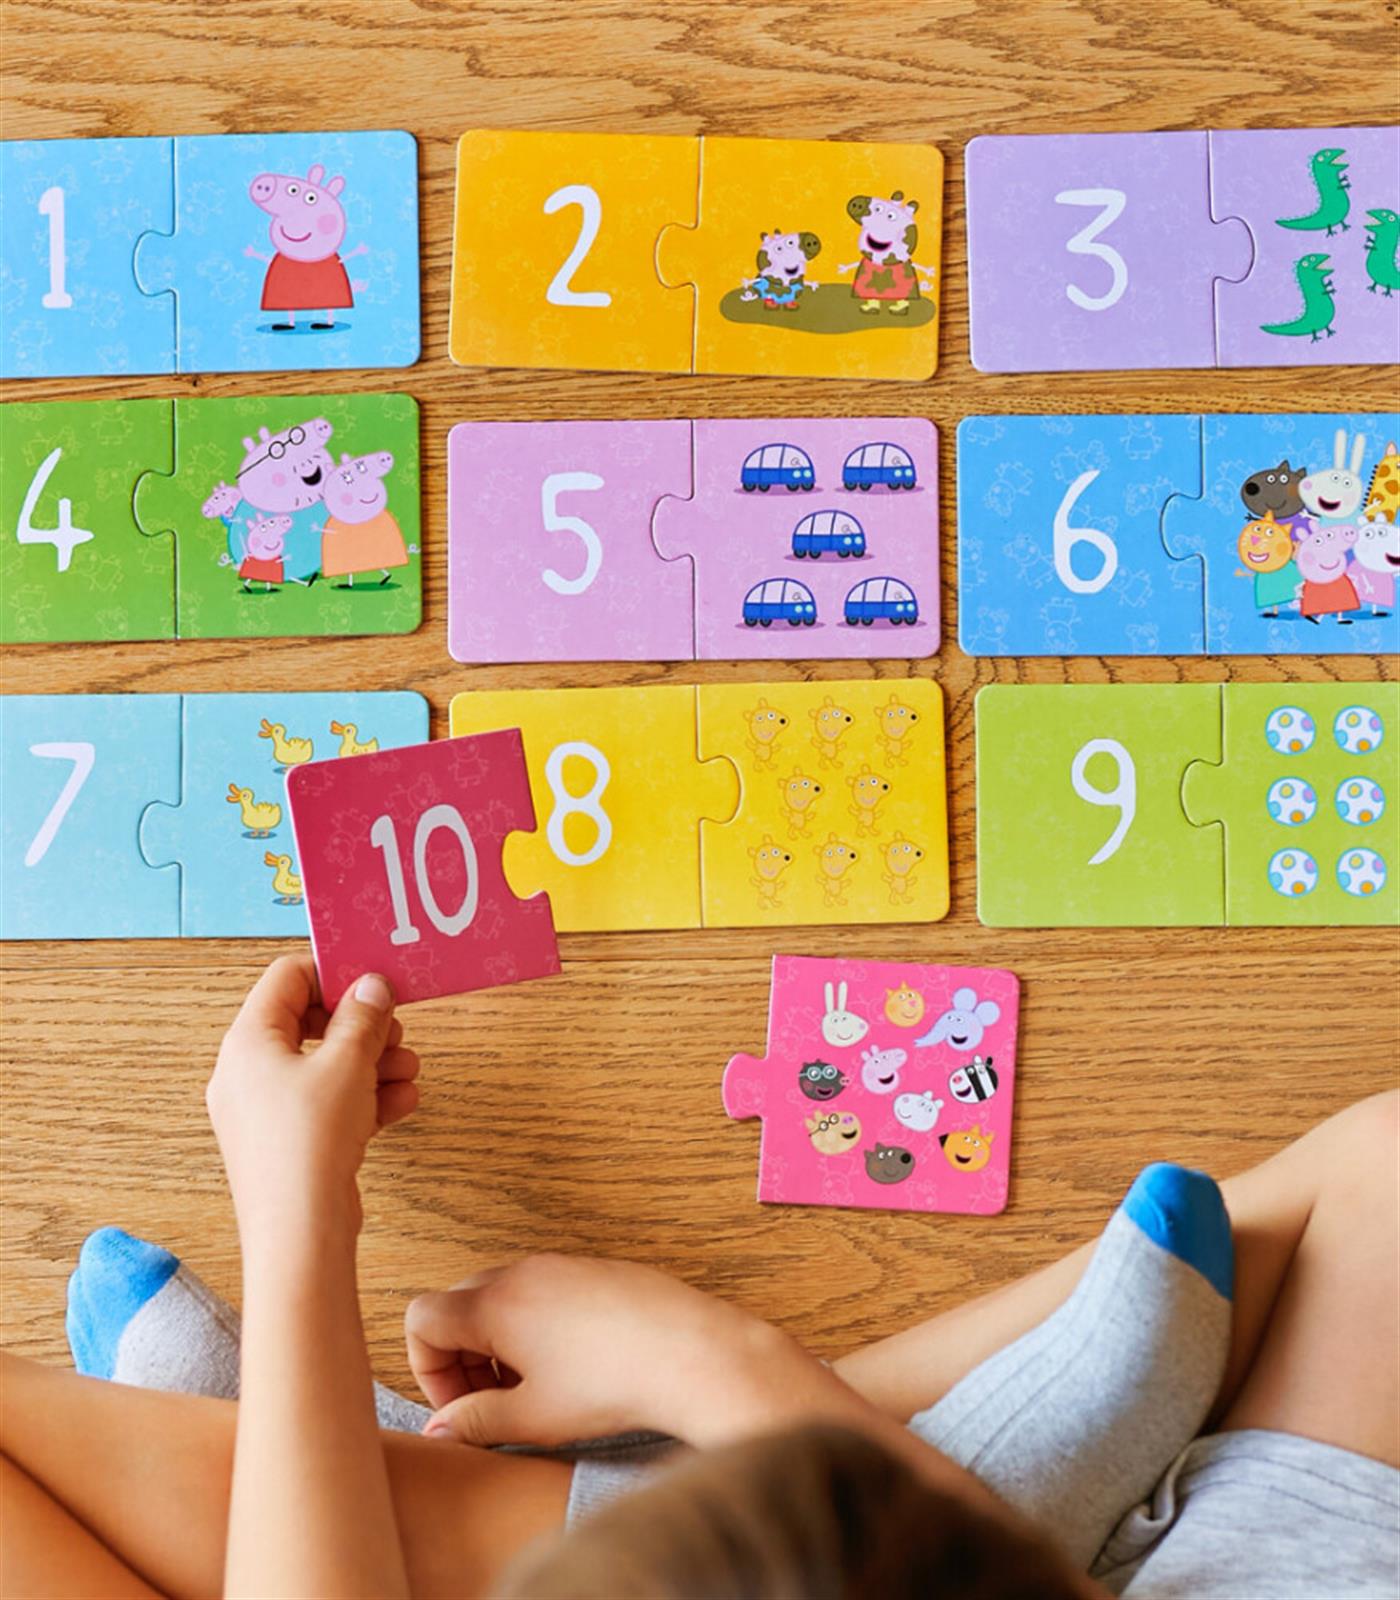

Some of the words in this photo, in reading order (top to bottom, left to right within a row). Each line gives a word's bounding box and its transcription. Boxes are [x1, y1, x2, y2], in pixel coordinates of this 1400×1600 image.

[38, 187, 73, 309] 1
[543, 185, 611, 307] 2
[1055, 188, 1129, 311] 3
[17, 447, 94, 572] 4
[541, 472, 604, 595] 5
[1051, 470, 1118, 594] 6
[24, 741, 95, 867] 7
[546, 741, 612, 866] 8
[1071, 738, 1137, 865] 9
[371, 805, 478, 946] 10
